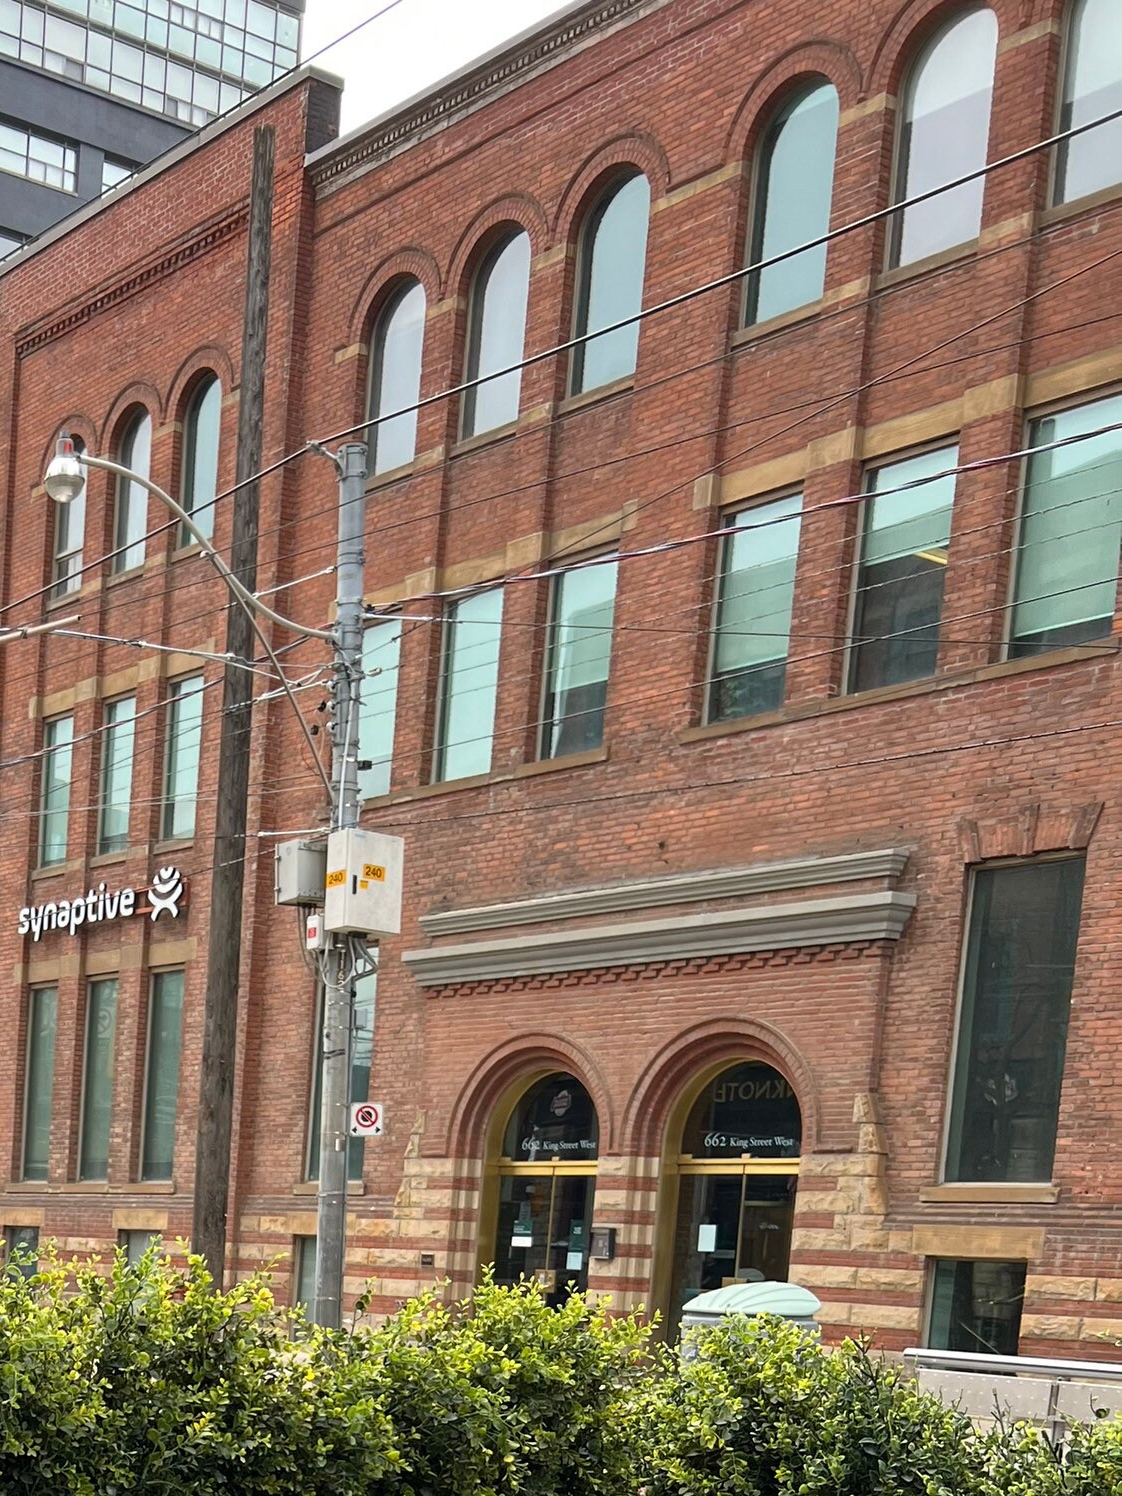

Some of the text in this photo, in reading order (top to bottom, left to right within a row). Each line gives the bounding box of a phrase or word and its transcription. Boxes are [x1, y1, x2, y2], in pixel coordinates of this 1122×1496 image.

[328, 872, 343, 885] 240
[365, 866, 382, 878] 240
[17, 882, 135, 942] synaptive
[521, 1137, 596, 1152] 662 King Street West
[704, 1133, 793, 1149] 662 King Street West
